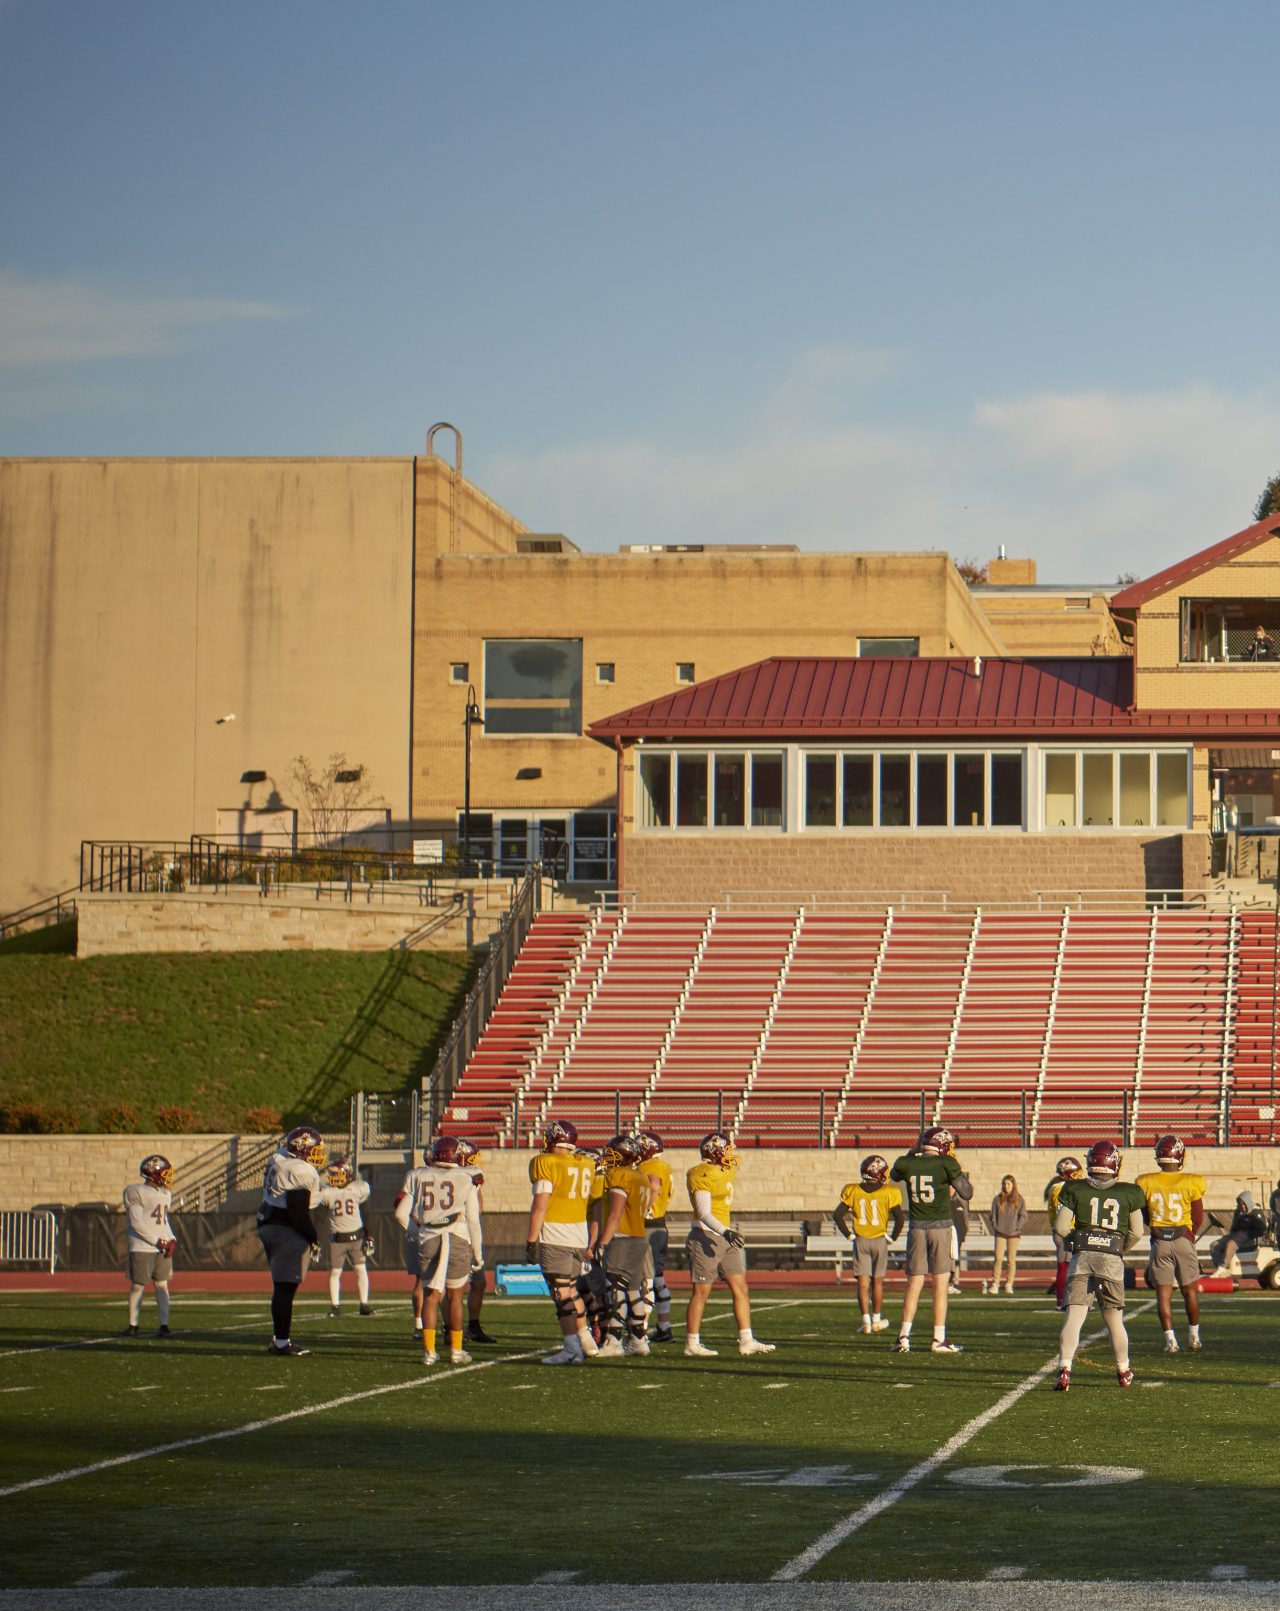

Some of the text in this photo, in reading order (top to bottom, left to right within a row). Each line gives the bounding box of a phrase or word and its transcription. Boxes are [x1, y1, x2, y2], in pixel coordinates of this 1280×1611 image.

[422, 1181, 454, 1211] 53
[567, 1167, 591, 1199] 76
[910, 1175, 935, 1203] 15
[334, 1199, 354, 1217] 26
[859, 1198, 880, 1226] 11
[1090, 1197, 1120, 1230] 13
[1151, 1192, 1182, 1223] 35
